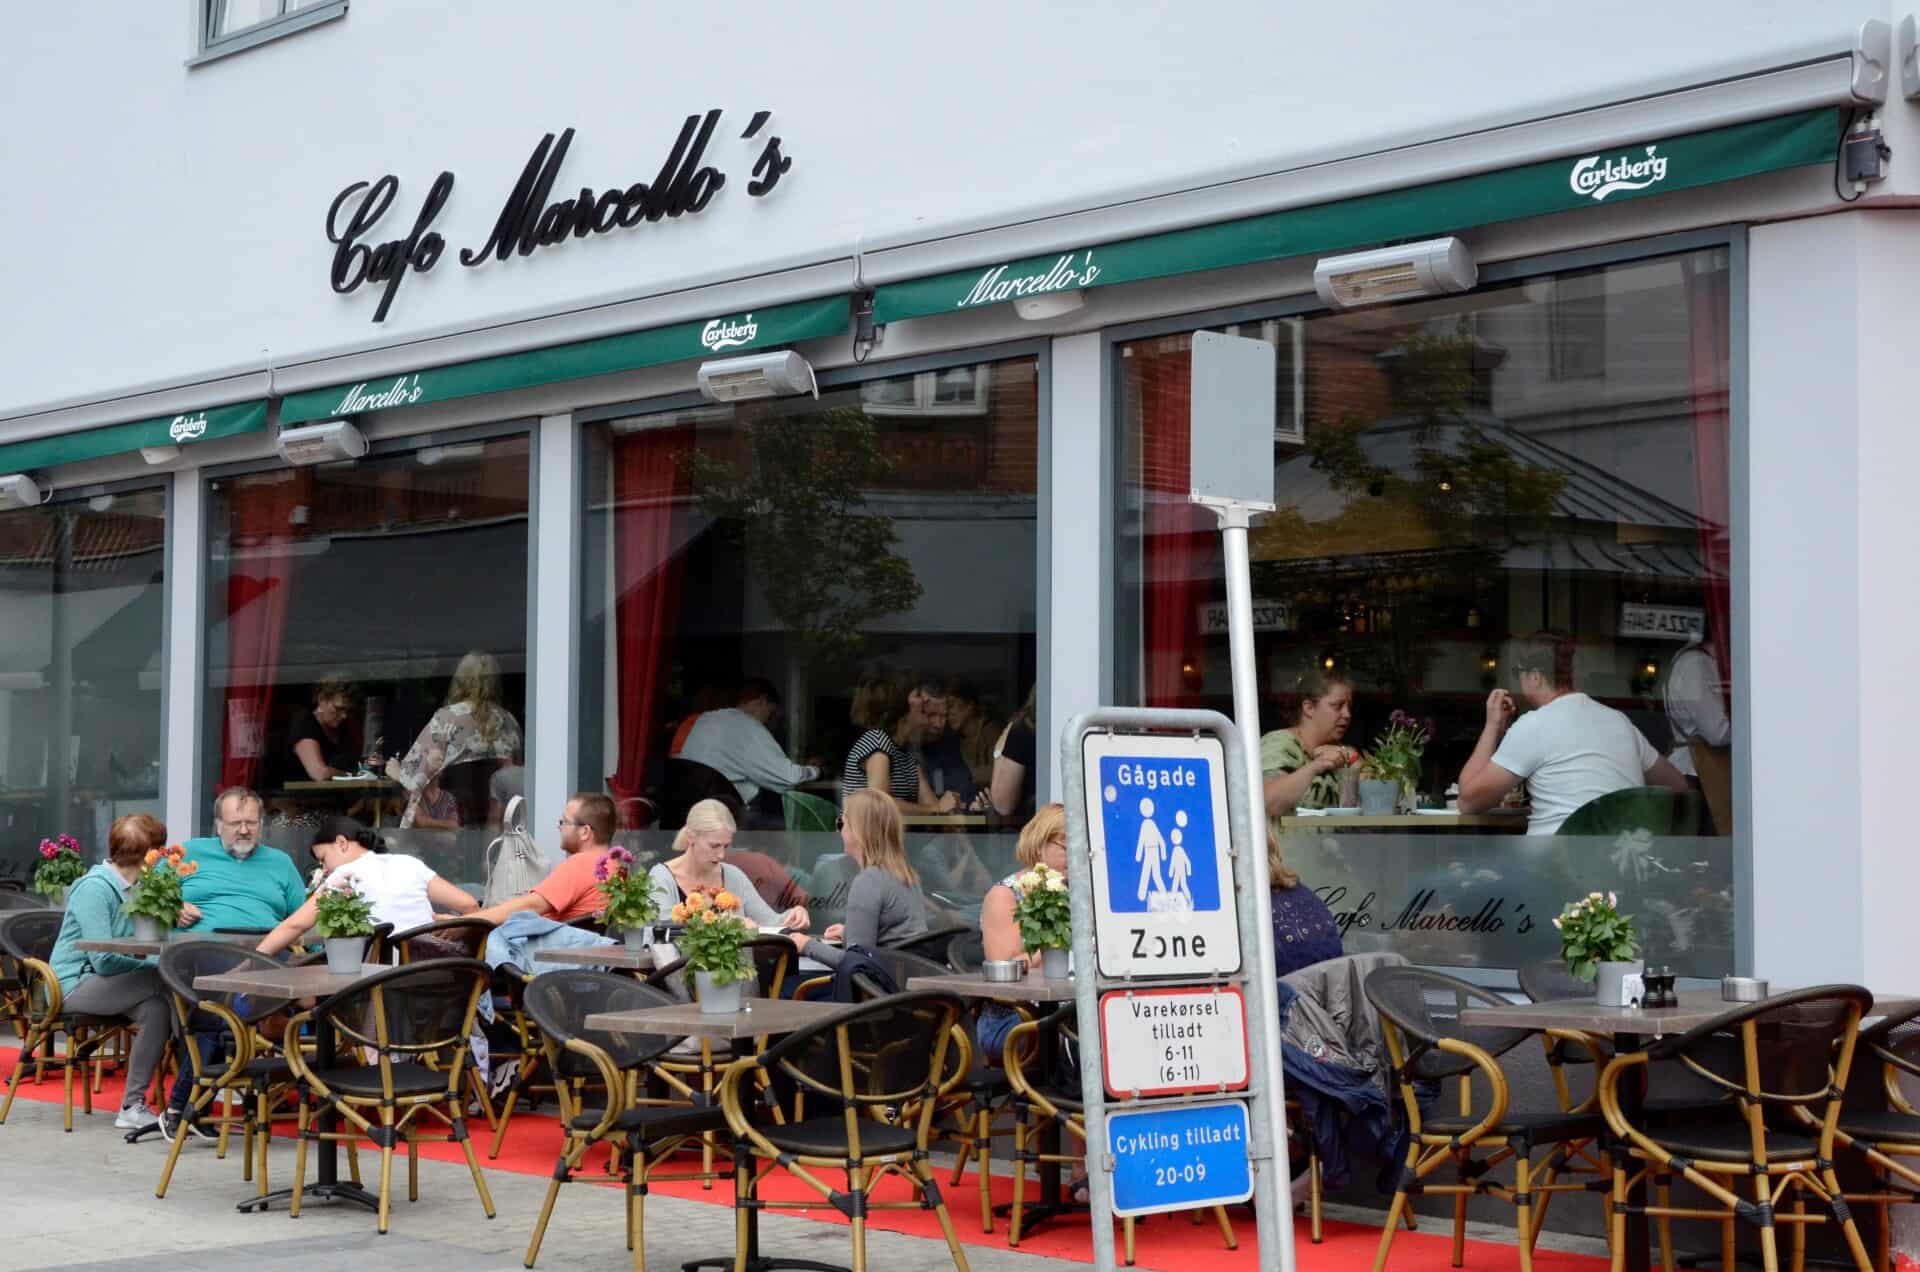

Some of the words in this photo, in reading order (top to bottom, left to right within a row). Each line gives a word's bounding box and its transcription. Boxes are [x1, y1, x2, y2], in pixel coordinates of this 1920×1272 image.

[1570, 146, 1668, 200] Carlsberg
[957, 250, 1101, 306] Marcello's
[701, 313, 758, 351] Carlsberg
[331, 374, 423, 416] Marcello's
[169, 413, 207, 442] Carlsberg
[1118, 764, 1196, 789] Gågade
[1381, 889, 1535, 934] Marcello's
[1130, 928, 1206, 959] Zone
[1131, 1000, 1219, 1018] Varekørsel
[1152, 1023, 1203, 1040] tilladt
[1165, 1046, 1193, 1061] 6-11
[1160, 1064, 1200, 1083] (6-11)
[1116, 1133, 1179, 1155] Cykling
[1186, 1124, 1241, 1145] tilladt
[1155, 1163, 1206, 1186] 20-09
